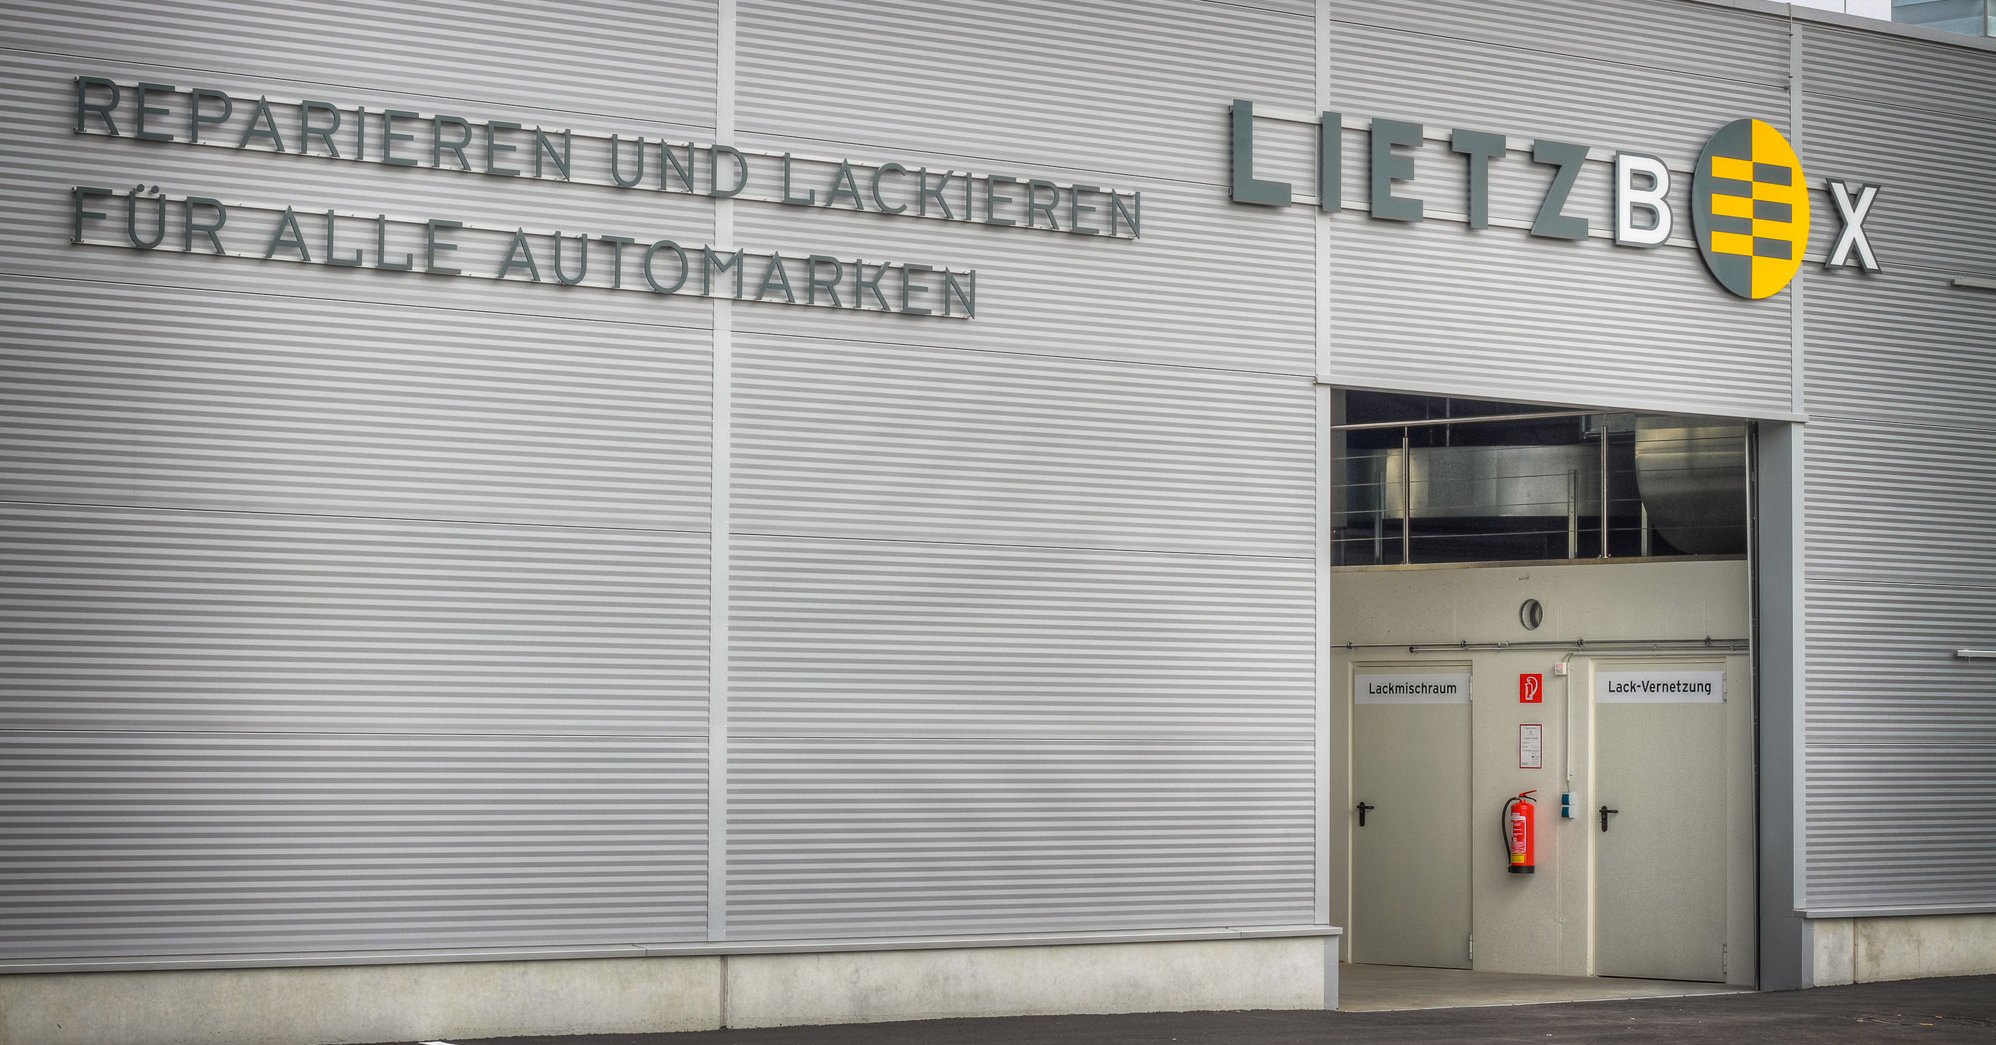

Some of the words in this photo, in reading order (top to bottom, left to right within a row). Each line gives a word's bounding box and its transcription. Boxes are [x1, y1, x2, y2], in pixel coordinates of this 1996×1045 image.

[75, 75, 572, 182] REPARIEREN
[611, 133, 749, 198] UND
[782, 151, 1142, 240] LACKIEREN
[72, 183, 227, 255] FÜR
[265, 204, 464, 276] ALLE
[499, 226, 976, 320] AUTOMARKEN
[1368, 681, 1458, 695] Lackmischraum
[1607, 680, 1713, 696] Lack-Vernetzung
